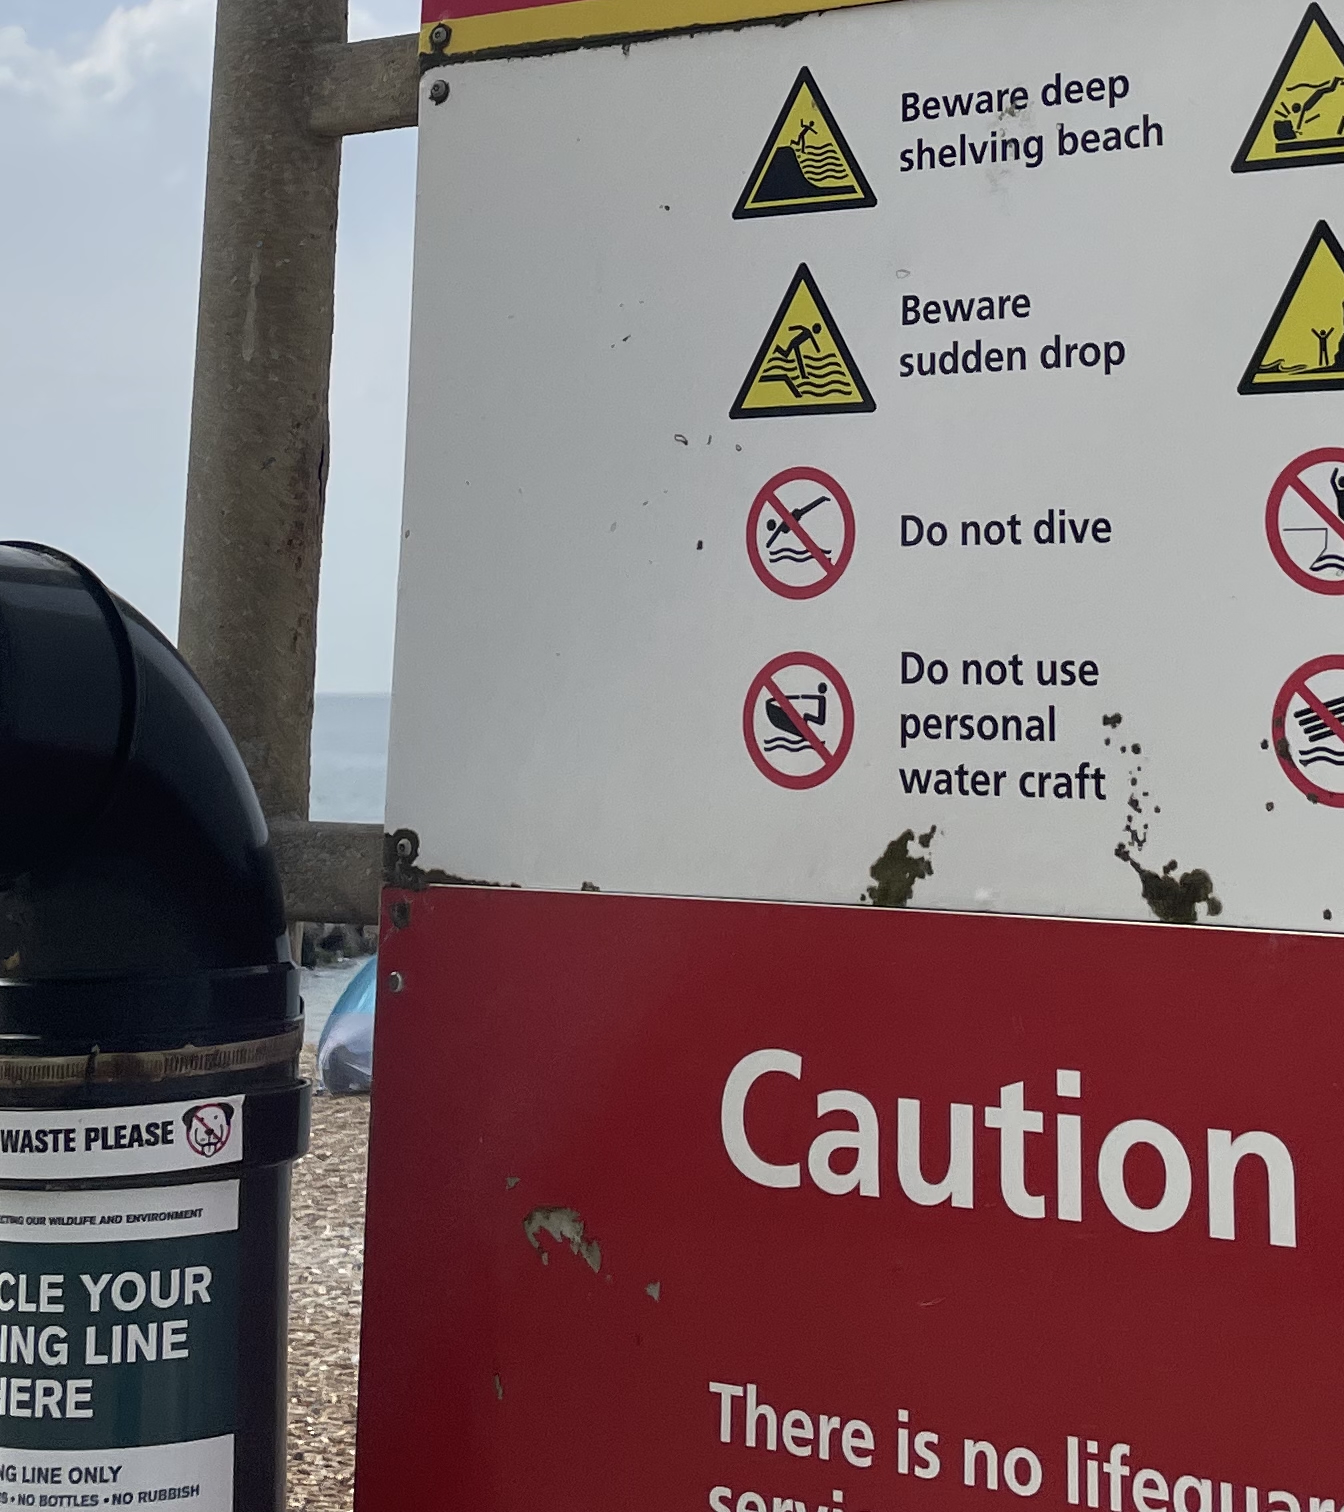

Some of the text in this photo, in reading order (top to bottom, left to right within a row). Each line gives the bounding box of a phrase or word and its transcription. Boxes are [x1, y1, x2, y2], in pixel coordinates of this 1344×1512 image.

[900, 73, 1129, 123] Beware deep
[899, 114, 1164, 172] shelving beach
[902, 295, 1030, 325] Beware
[900, 335, 1125, 377] sudden drop
[901, 509, 1111, 546] Do not dive
[902, 652, 1099, 686] Do not use
[901, 705, 1055, 748] personal
[899, 762, 1106, 800] water craft
[0, 1128, 76, 1153] WASTE
[84, 1119, 174, 1152] PLEASE
[721, 1049, 1296, 1247] Caution
[25, 1216, 47, 1226] OUR
[49, 1215, 97, 1226] WILDLIFE
[99, 1213, 123, 1226] AND
[126, 1208, 204, 1225] ENVIRONMENT
[79, 1265, 213, 1314] YOUR
[84, 1319, 190, 1366] LINE
[710, 1382, 874, 1467] There
[898, 1409, 940, 1478] is
[964, 1439, 1042, 1496] no
[21, 1465, 62, 1484] LINE
[68, 1465, 123, 1485] ONLY
[17, 1493, 36, 1506] NO
[39, 1494, 99, 1507] BOTTLES
[111, 1492, 134, 1506] NO
[137, 1484, 200, 1504] RUBBISH
